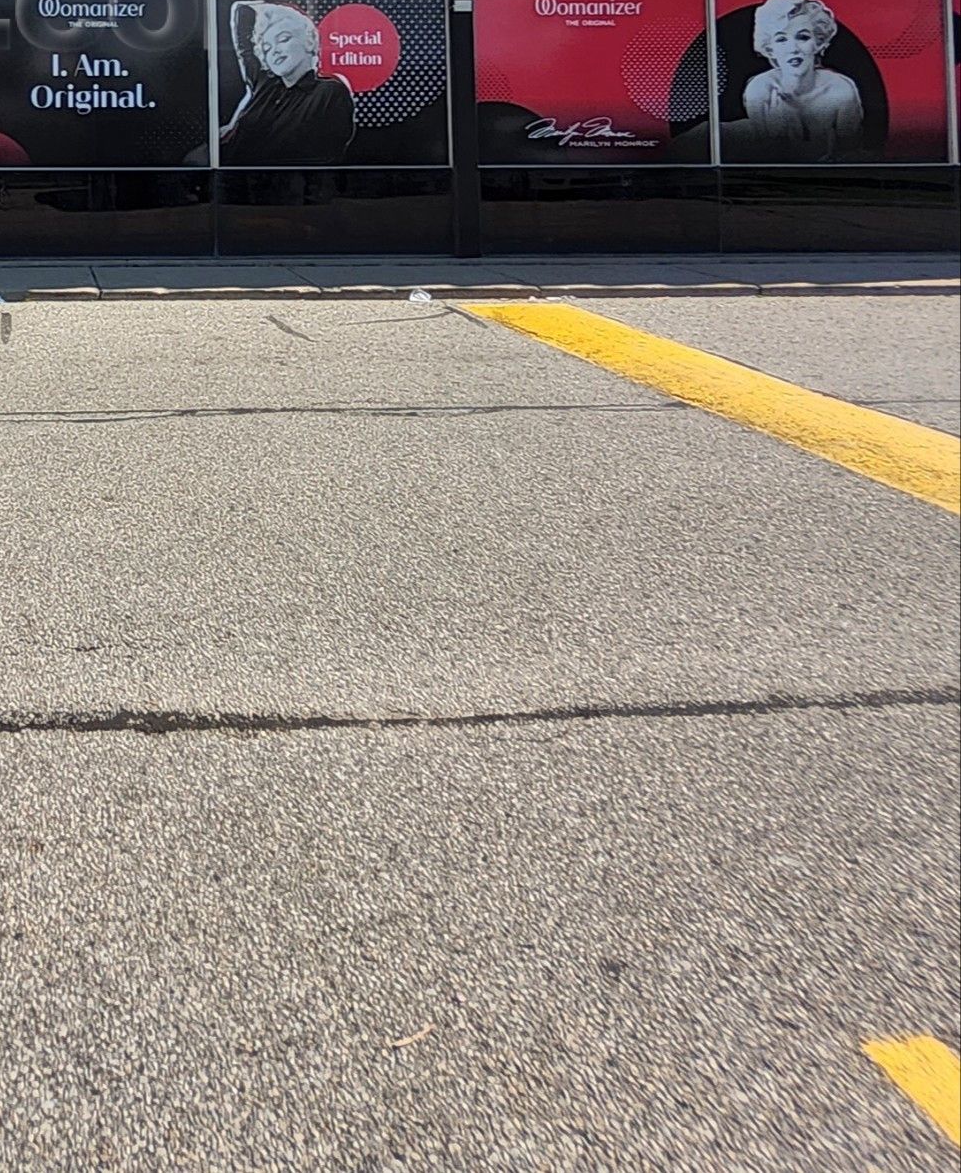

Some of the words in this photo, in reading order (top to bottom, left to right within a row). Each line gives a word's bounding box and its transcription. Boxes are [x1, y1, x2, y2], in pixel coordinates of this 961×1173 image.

[38, 0, 145, 17] Womanizer
[329, 31, 382, 48] Special
[75, 54, 129, 77] Am.
[331, 52, 382, 66] Edition
[31, 84, 156, 115] Original.
